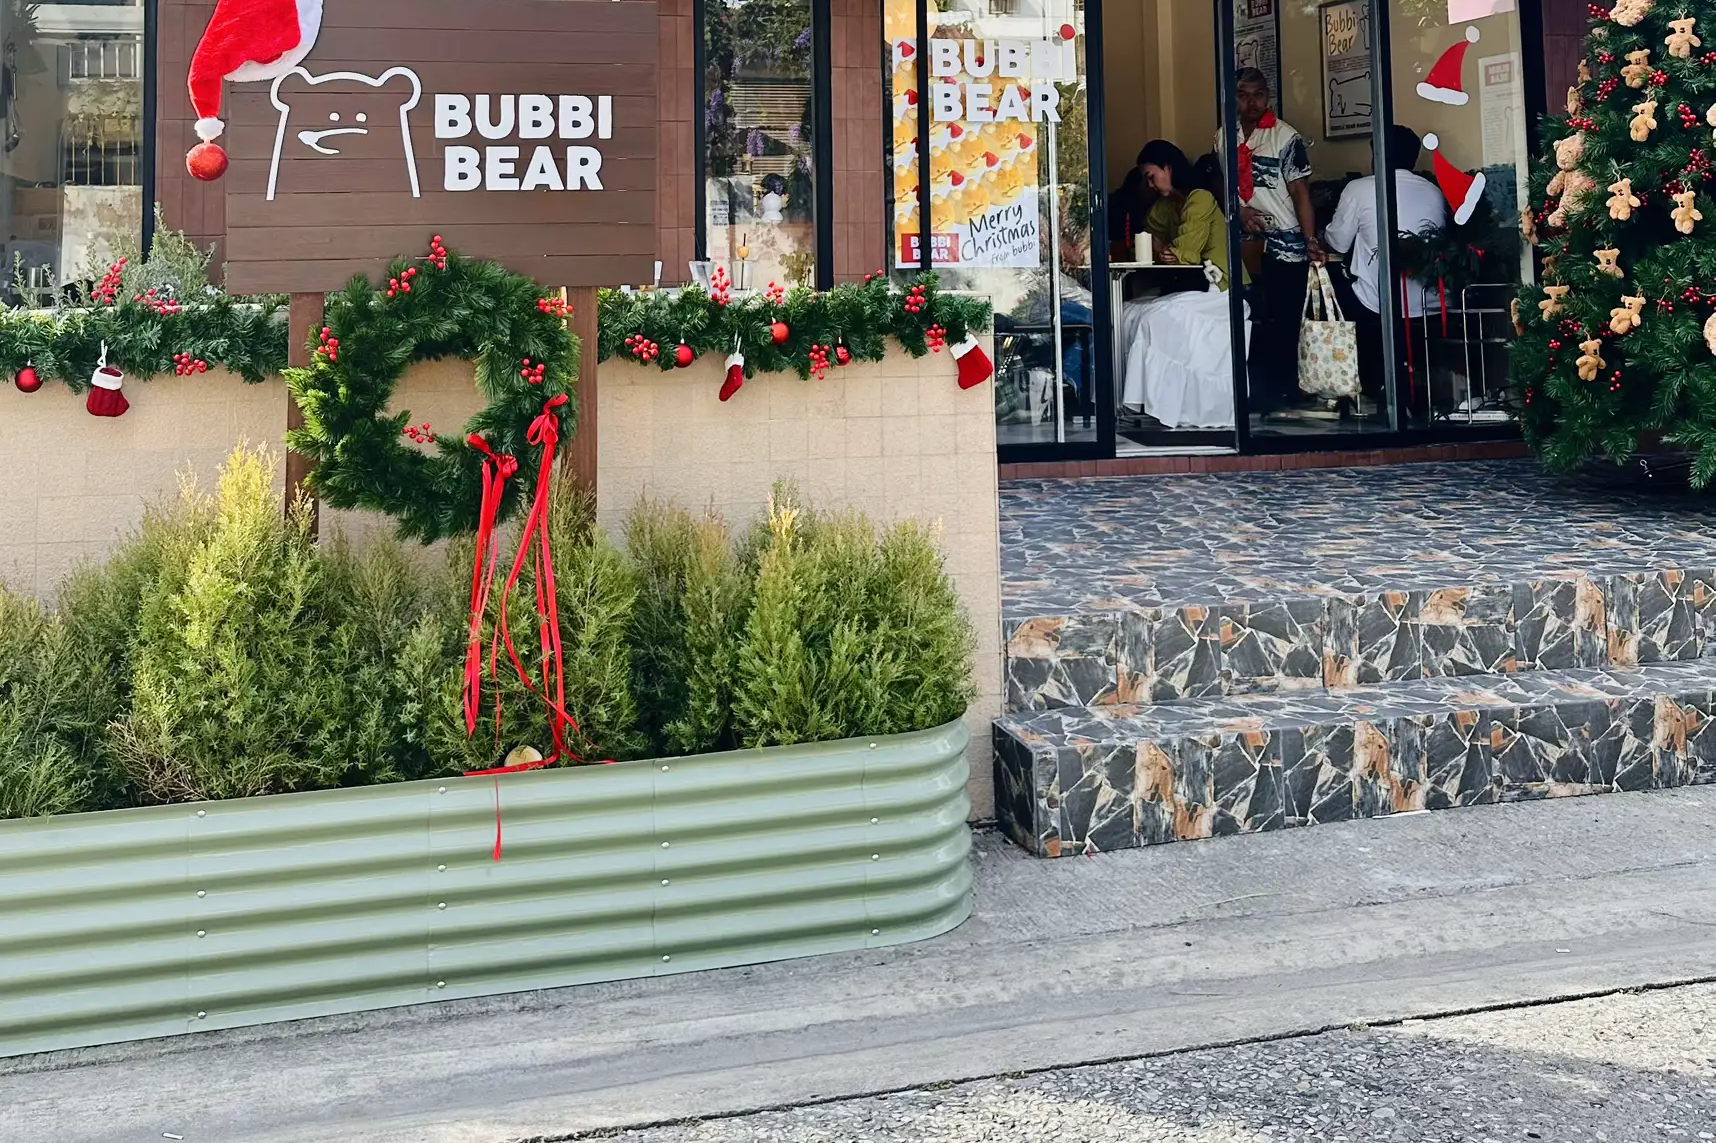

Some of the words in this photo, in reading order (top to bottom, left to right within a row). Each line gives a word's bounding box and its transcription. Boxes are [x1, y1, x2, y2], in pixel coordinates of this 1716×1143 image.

[1325, 10, 1357, 36] Bubbi
[1328, 33, 1354, 56] Bear
[434, 93, 612, 139] BUBBI
[933, 84, 1062, 122] BEAR
[444, 145, 604, 191] BEAR
[969, 204, 1023, 237] Merry
[910, 236, 951, 248] BBBI
[912, 248, 949, 260] BAR
[961, 220, 1036, 261] Christmas
[1012, 240, 1036, 257] bubbi
